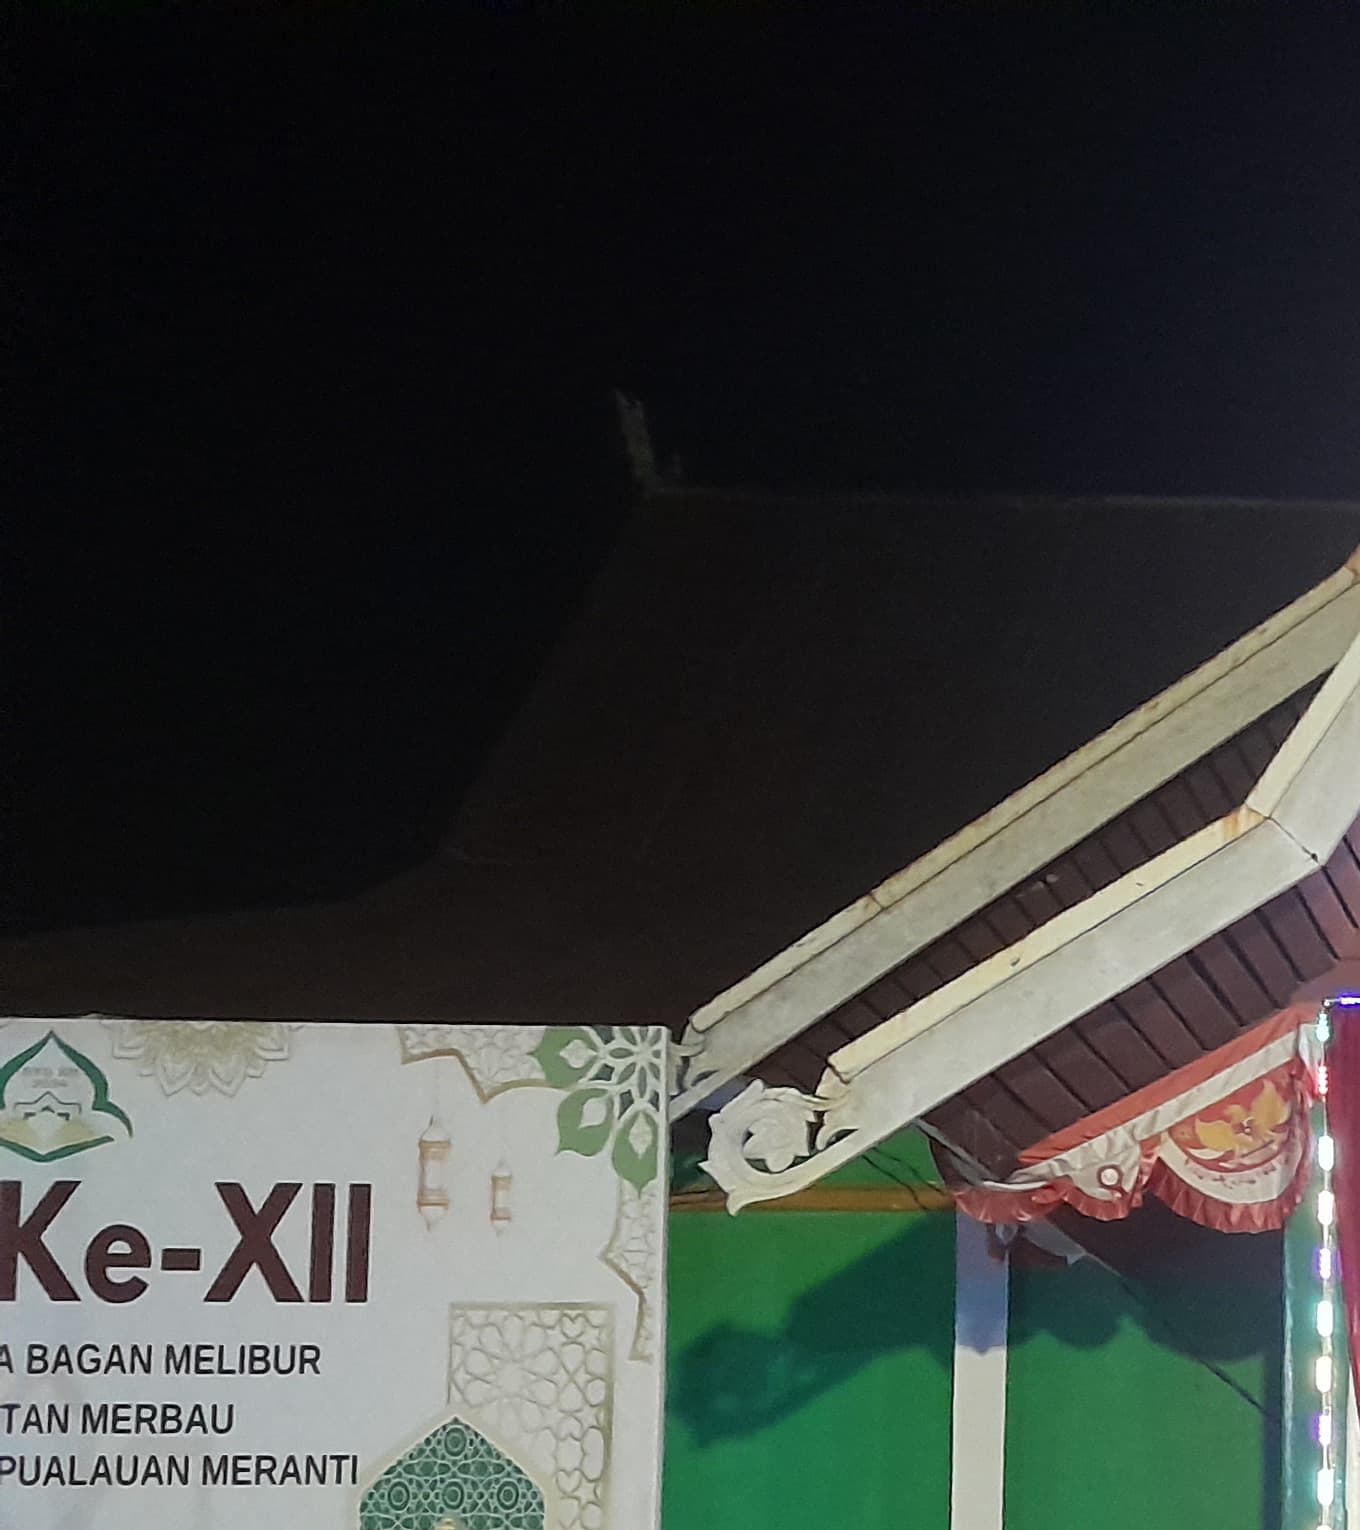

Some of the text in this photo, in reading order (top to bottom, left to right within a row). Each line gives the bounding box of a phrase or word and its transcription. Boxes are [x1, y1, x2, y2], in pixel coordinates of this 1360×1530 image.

[0, 1180, 371, 1304] Ke-XII
[26, 1344, 153, 1376] BAGAN
[165, 1344, 322, 1376] MELIBUR
[81, 1403, 235, 1435] MERBAU
[201, 1454, 359, 1486] MERANTI
